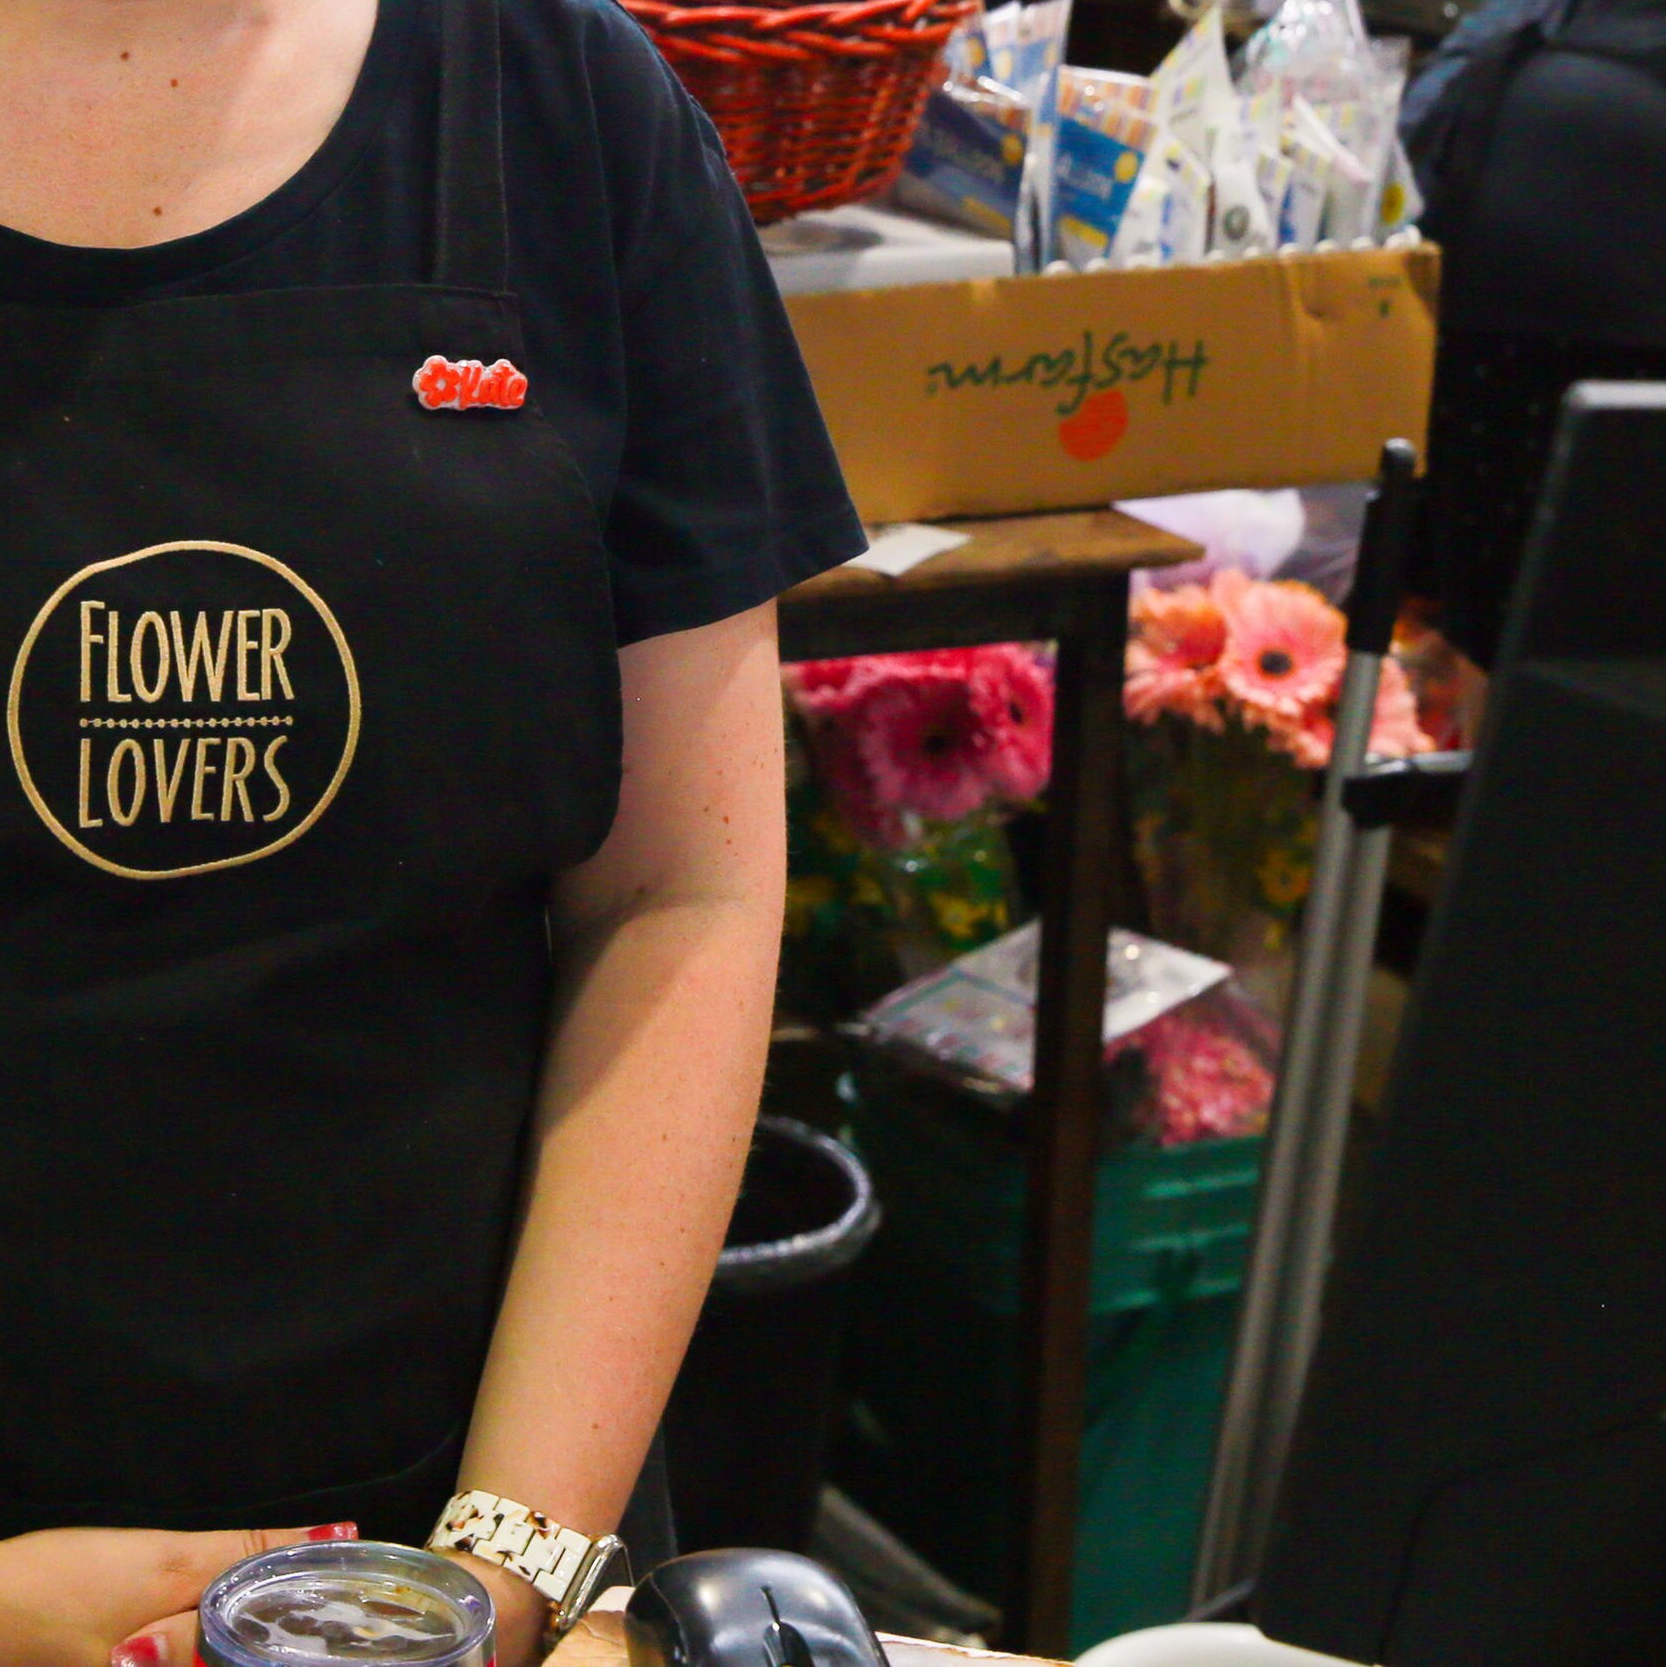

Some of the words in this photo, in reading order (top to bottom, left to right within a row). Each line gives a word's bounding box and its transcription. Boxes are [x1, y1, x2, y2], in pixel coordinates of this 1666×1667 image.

[460, 365, 527, 407] Kate
[80, 600, 295, 704] FLOWER
[79, 735, 291, 829] LOVERS
